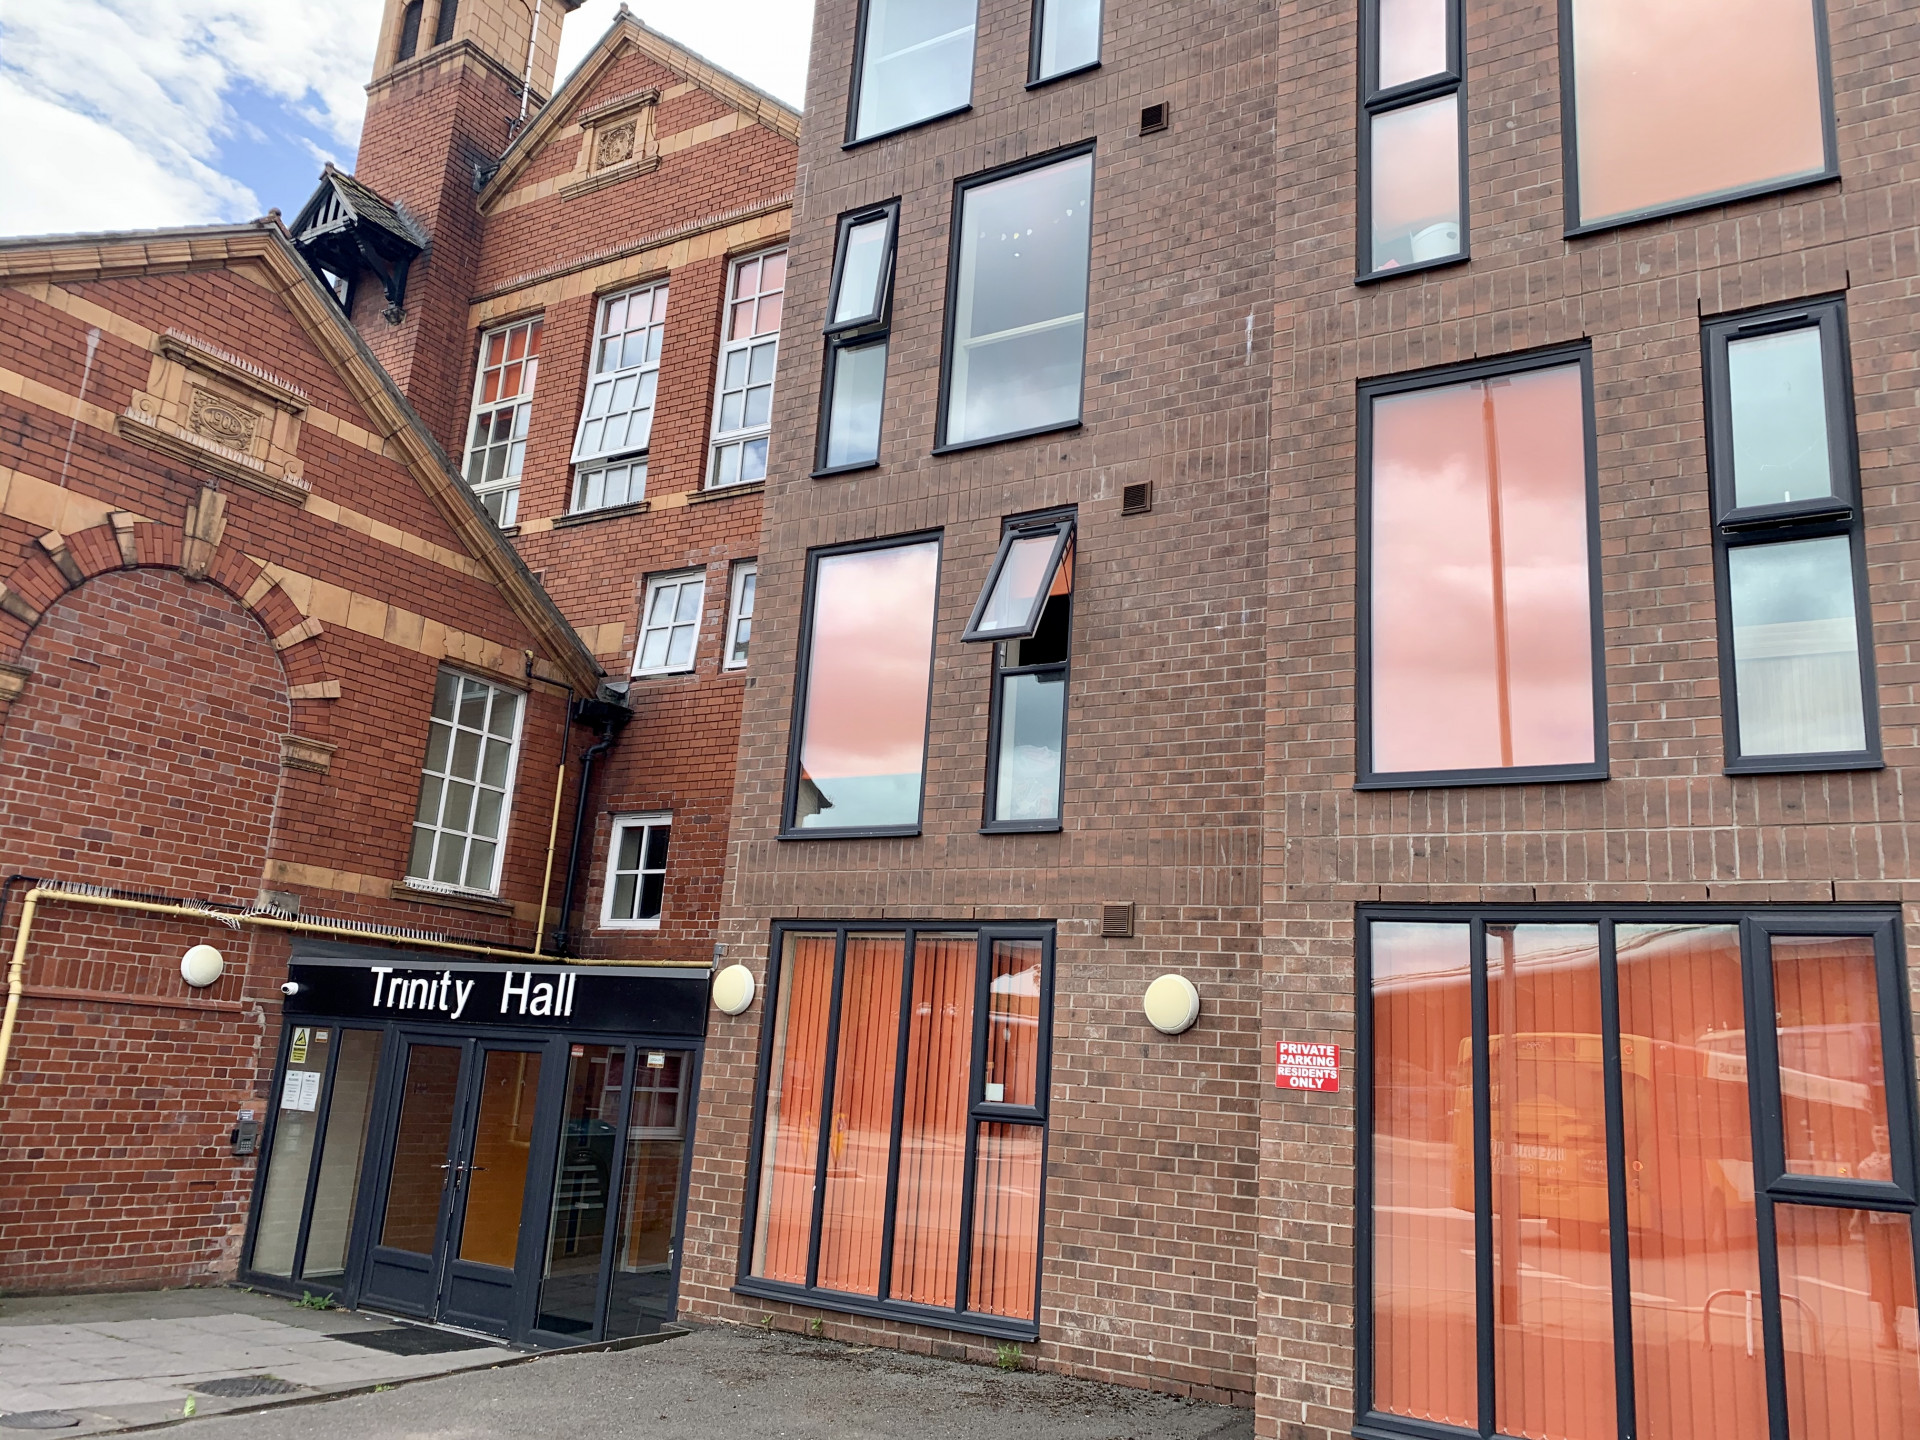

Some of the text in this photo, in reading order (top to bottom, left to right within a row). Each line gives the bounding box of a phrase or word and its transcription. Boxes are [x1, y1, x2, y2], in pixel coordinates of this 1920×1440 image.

[371, 966, 576, 1020] Trinity Hall
[1280, 1043, 1335, 1056] PRIVATE
[1280, 1054, 1335, 1067] PARKING
[1277, 1066, 1337, 1079] RESIDENTS
[1289, 1077, 1324, 1088] ONLY
